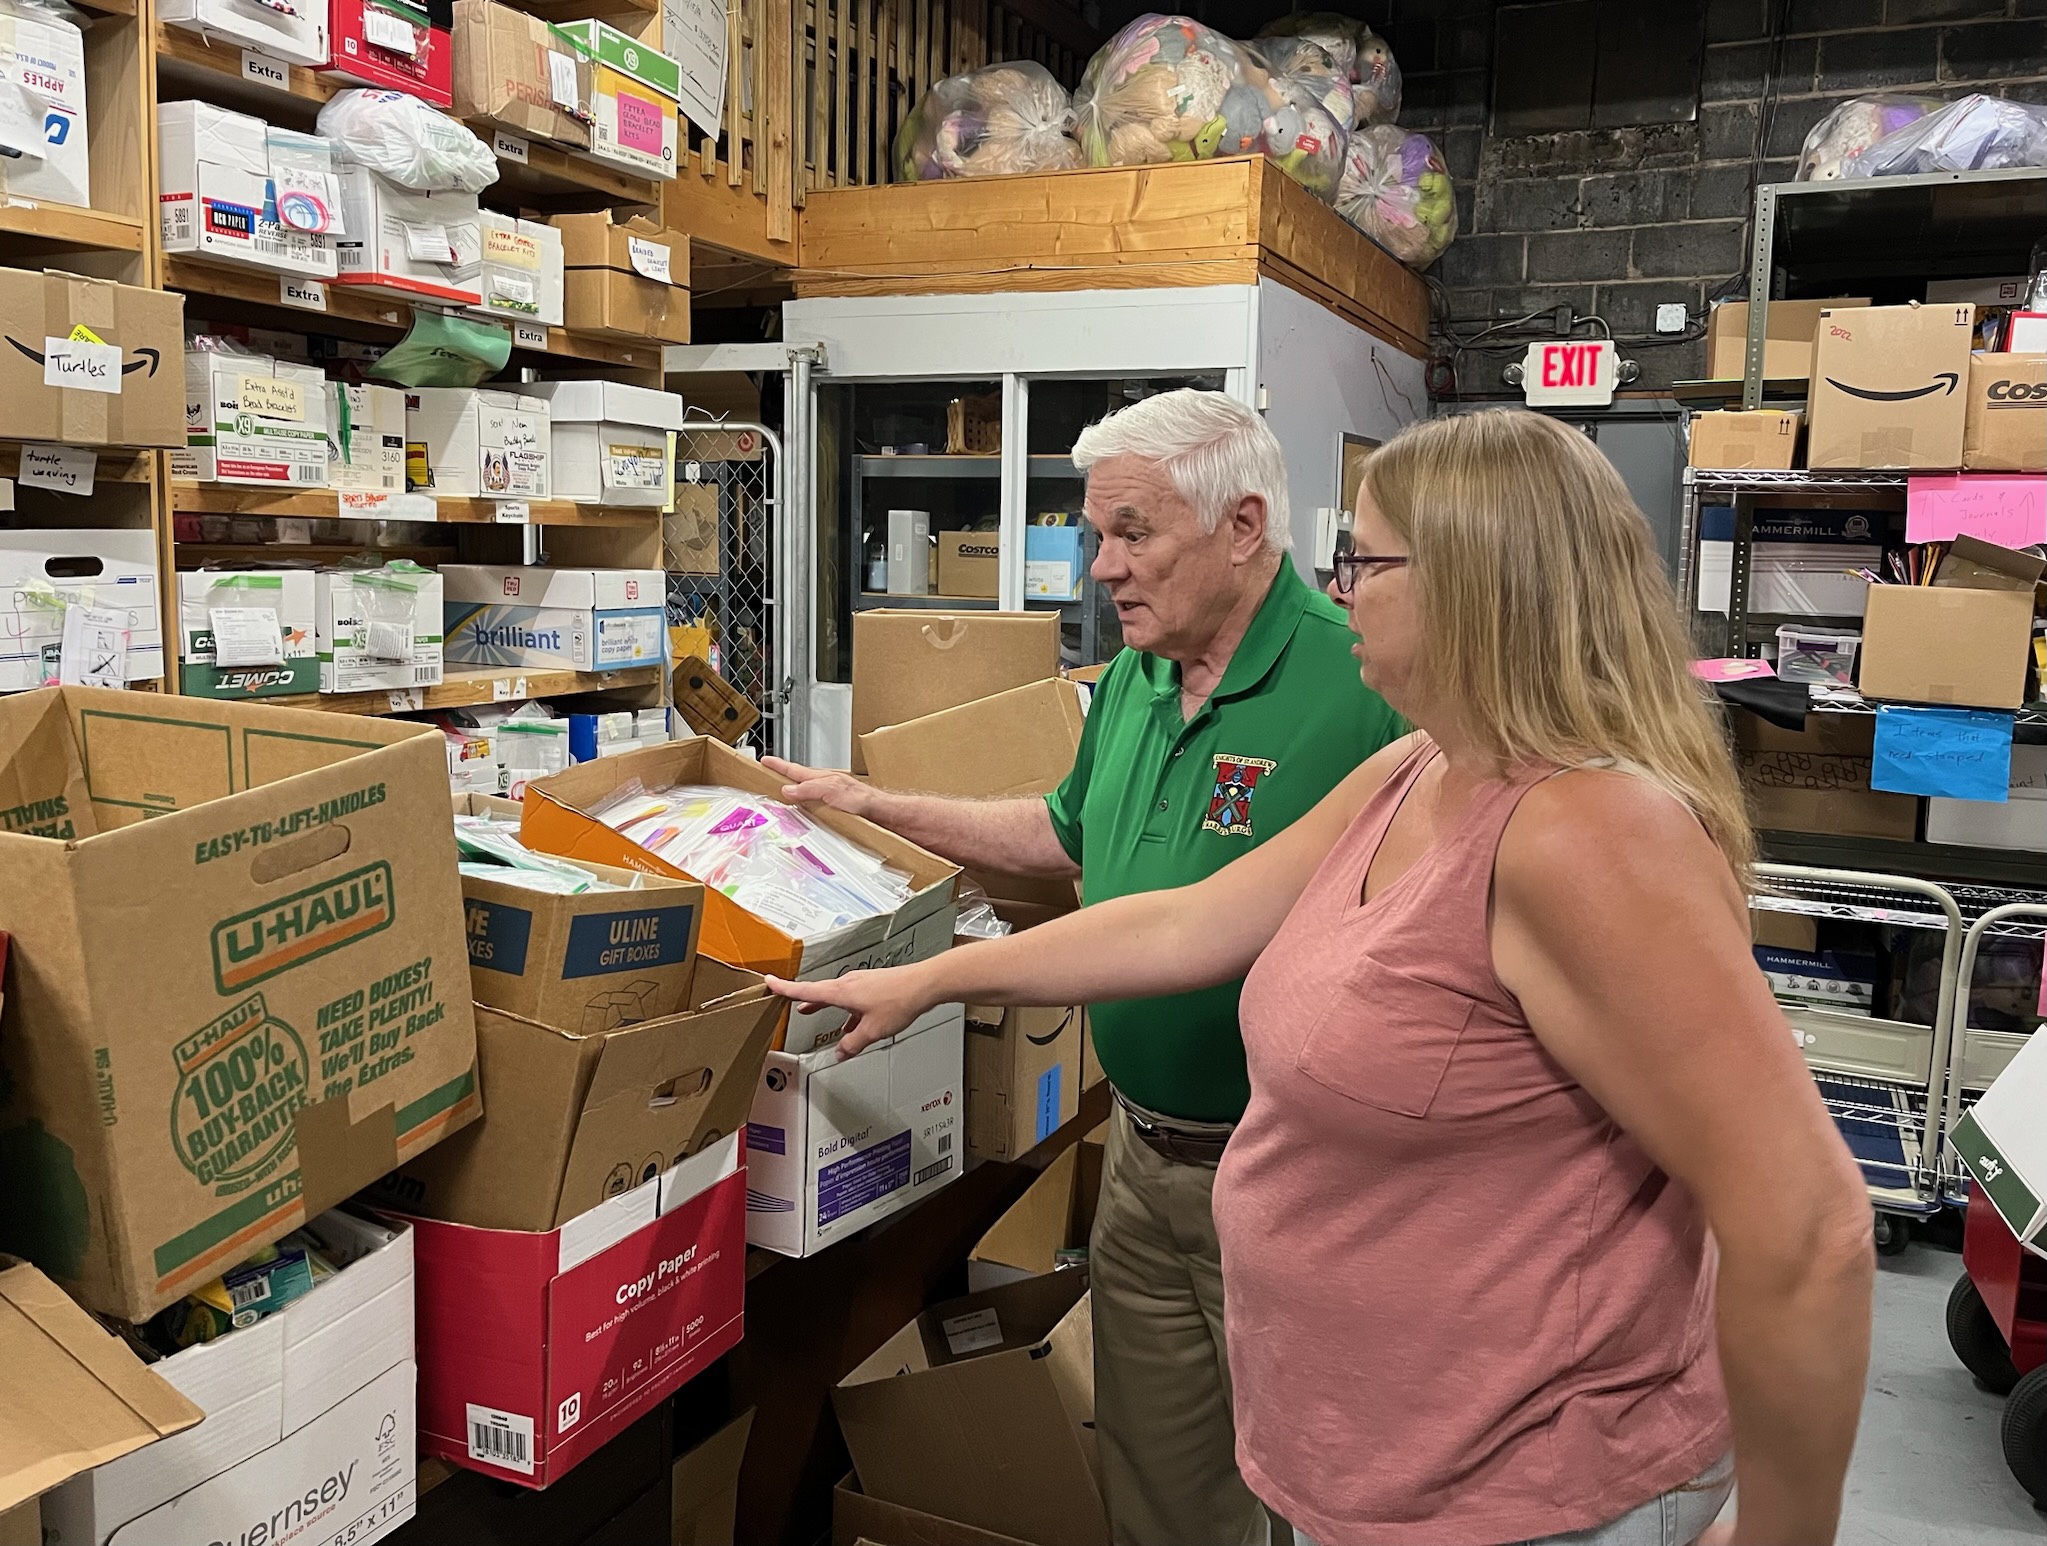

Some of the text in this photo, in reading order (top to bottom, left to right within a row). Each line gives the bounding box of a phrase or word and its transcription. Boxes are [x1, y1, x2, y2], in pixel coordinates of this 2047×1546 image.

[249, 61, 283, 82] Extra
[24, 72, 65, 94] APPLES
[623, 103, 645, 116] EXTRA
[498, 140, 523, 156] Extra
[174, 207, 189, 224] 5891
[310, 233, 326, 249] 5891
[287, 286, 320, 302] Extra
[519, 329, 543, 343] Extra
[1829, 325, 1853, 342] 2022
[51, 354, 106, 377] Turtles
[1542, 345, 1603, 387] EXIT
[244, 379, 266, 394] Extra
[266, 398, 297, 414] Bracelets
[238, 418, 251, 434] X9
[27, 450, 61, 465] turtle
[381, 451, 400, 464] 3160
[509, 451, 545, 461] FLAGSHIP
[32, 467, 77, 486] weaving
[501, 512, 523, 520] Keychain
[1960, 506, 2015, 520] Journals
[1752, 525, 1837, 537] AMMERMILL
[958, 543, 999, 555] COSTCO
[475, 624, 561, 650] brilliant
[601, 637, 623, 646] brilliant
[616, 645, 632, 653] paper
[215, 670, 295, 690] COMET
[1892, 723, 1982, 743] Items that
[1215, 755, 1236, 763] KNIGHTS
[1923, 751, 1985, 767] stamped
[195, 782, 387, 865] EASY-TO-LIFT-HANDLES
[225, 874, 386, 964] U-HAUL
[609, 916, 660, 945] ULINE
[600, 943, 661, 967] GIFT BOXES
[1766, 955, 1832, 969] HAMMERMILL
[316, 956, 433, 1031] NEED BOXES?
[318, 980, 434, 1056] TAKE PLENTY!
[178, 997, 262, 1065] U-HAUL
[320, 1001, 446, 1081] We'll Buy Back
[184, 1027, 285, 1122] 100%
[323, 1044, 416, 1101] the Extras.
[186, 1057, 307, 1162] BUY-BACK
[920, 1097, 942, 1114] xerox
[817, 1128, 870, 1159] Bold Digital
[818, 1211, 828, 1223] 24
[615, 1244, 698, 1305] Copy Paper
[585, 1325, 603, 1343] Best
[602, 1319, 614, 1335] for
[613, 1308, 631, 1327] high
[630, 1291, 657, 1313] volume,
[656, 1279, 675, 1297] black
[680, 1264, 698, 1283] white
[697, 1249, 720, 1272] printing
[686, 1315, 705, 1335] 5000
[632, 1358, 643, 1371] 92
[561, 1398, 579, 1422] 10
[378, 1434, 396, 1452] FSC
[306, 1503, 337, 1527] source
